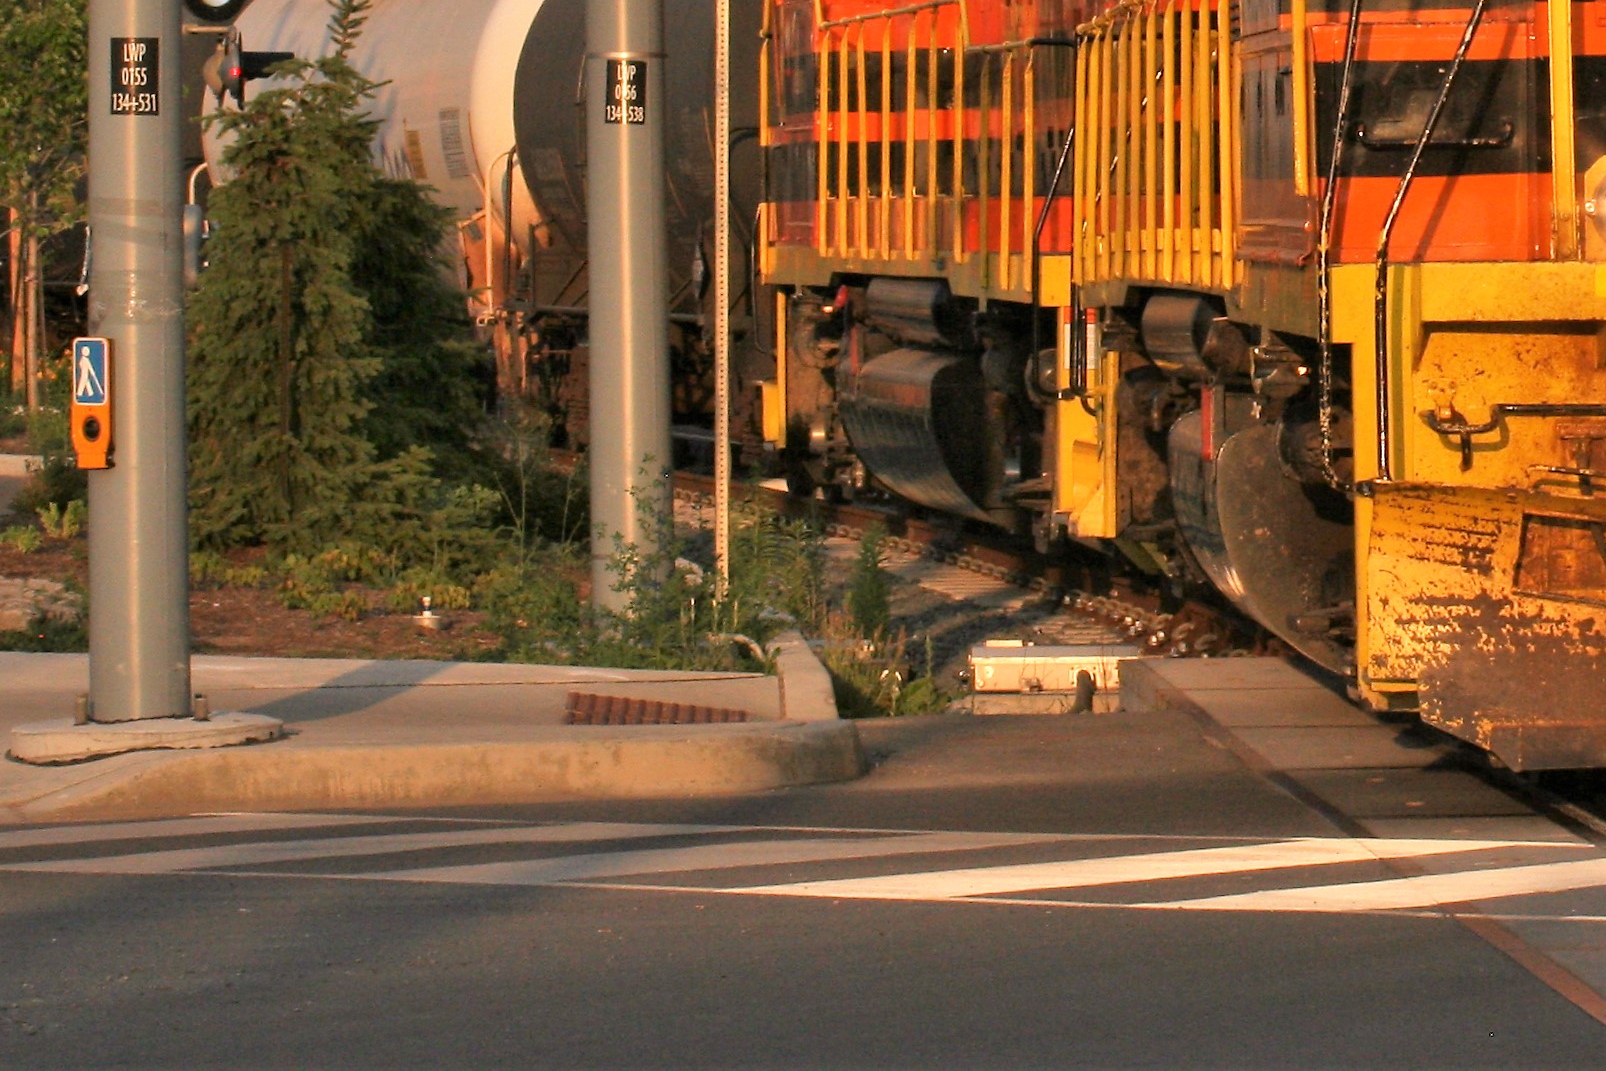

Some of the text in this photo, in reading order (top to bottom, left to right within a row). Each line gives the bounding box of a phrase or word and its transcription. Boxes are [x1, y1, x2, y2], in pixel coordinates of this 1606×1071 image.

[123, 42, 147, 62] LWP
[121, 67, 148, 86] 0155
[614, 84, 637, 100] 056
[112, 93, 157, 112] 134+531
[606, 105, 644, 122] 134538
